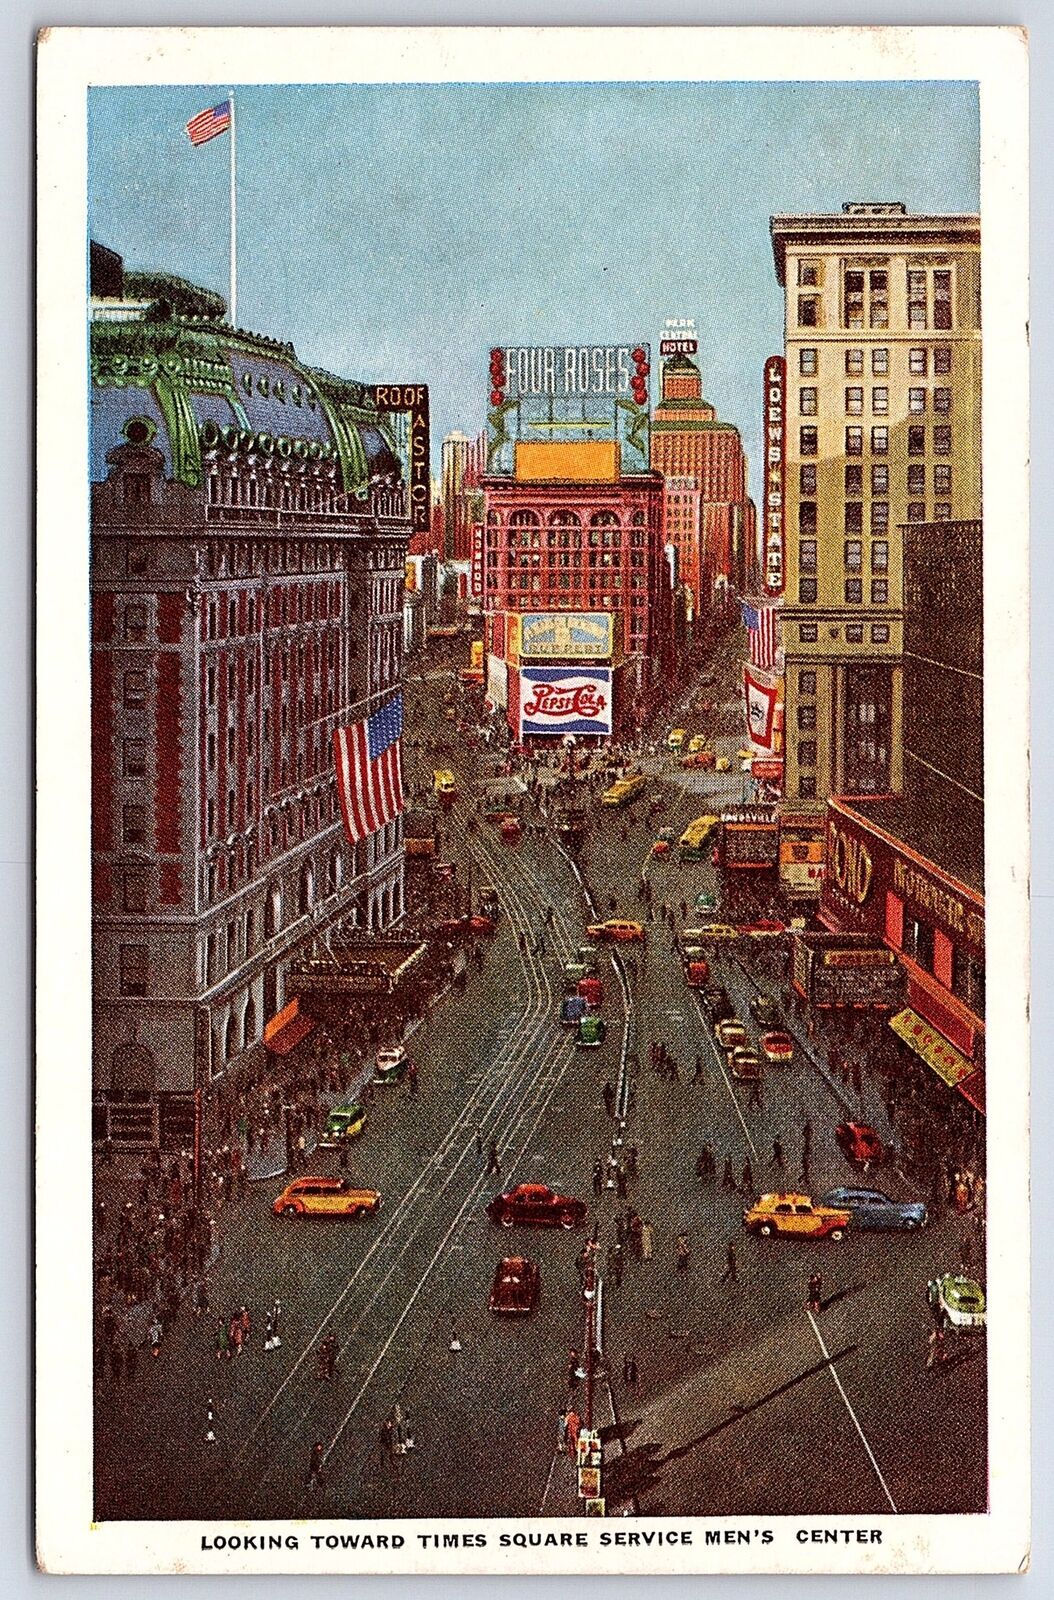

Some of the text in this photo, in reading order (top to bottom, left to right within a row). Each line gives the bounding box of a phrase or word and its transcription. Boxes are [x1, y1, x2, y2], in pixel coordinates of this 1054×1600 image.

[662, 341, 695, 353] HOTEL
[505, 348, 630, 394] FOUR ROSES
[376, 386, 425, 406] ROOF
[412, 413, 428, 525] ASTOR
[767, 492, 783, 587] STATE
